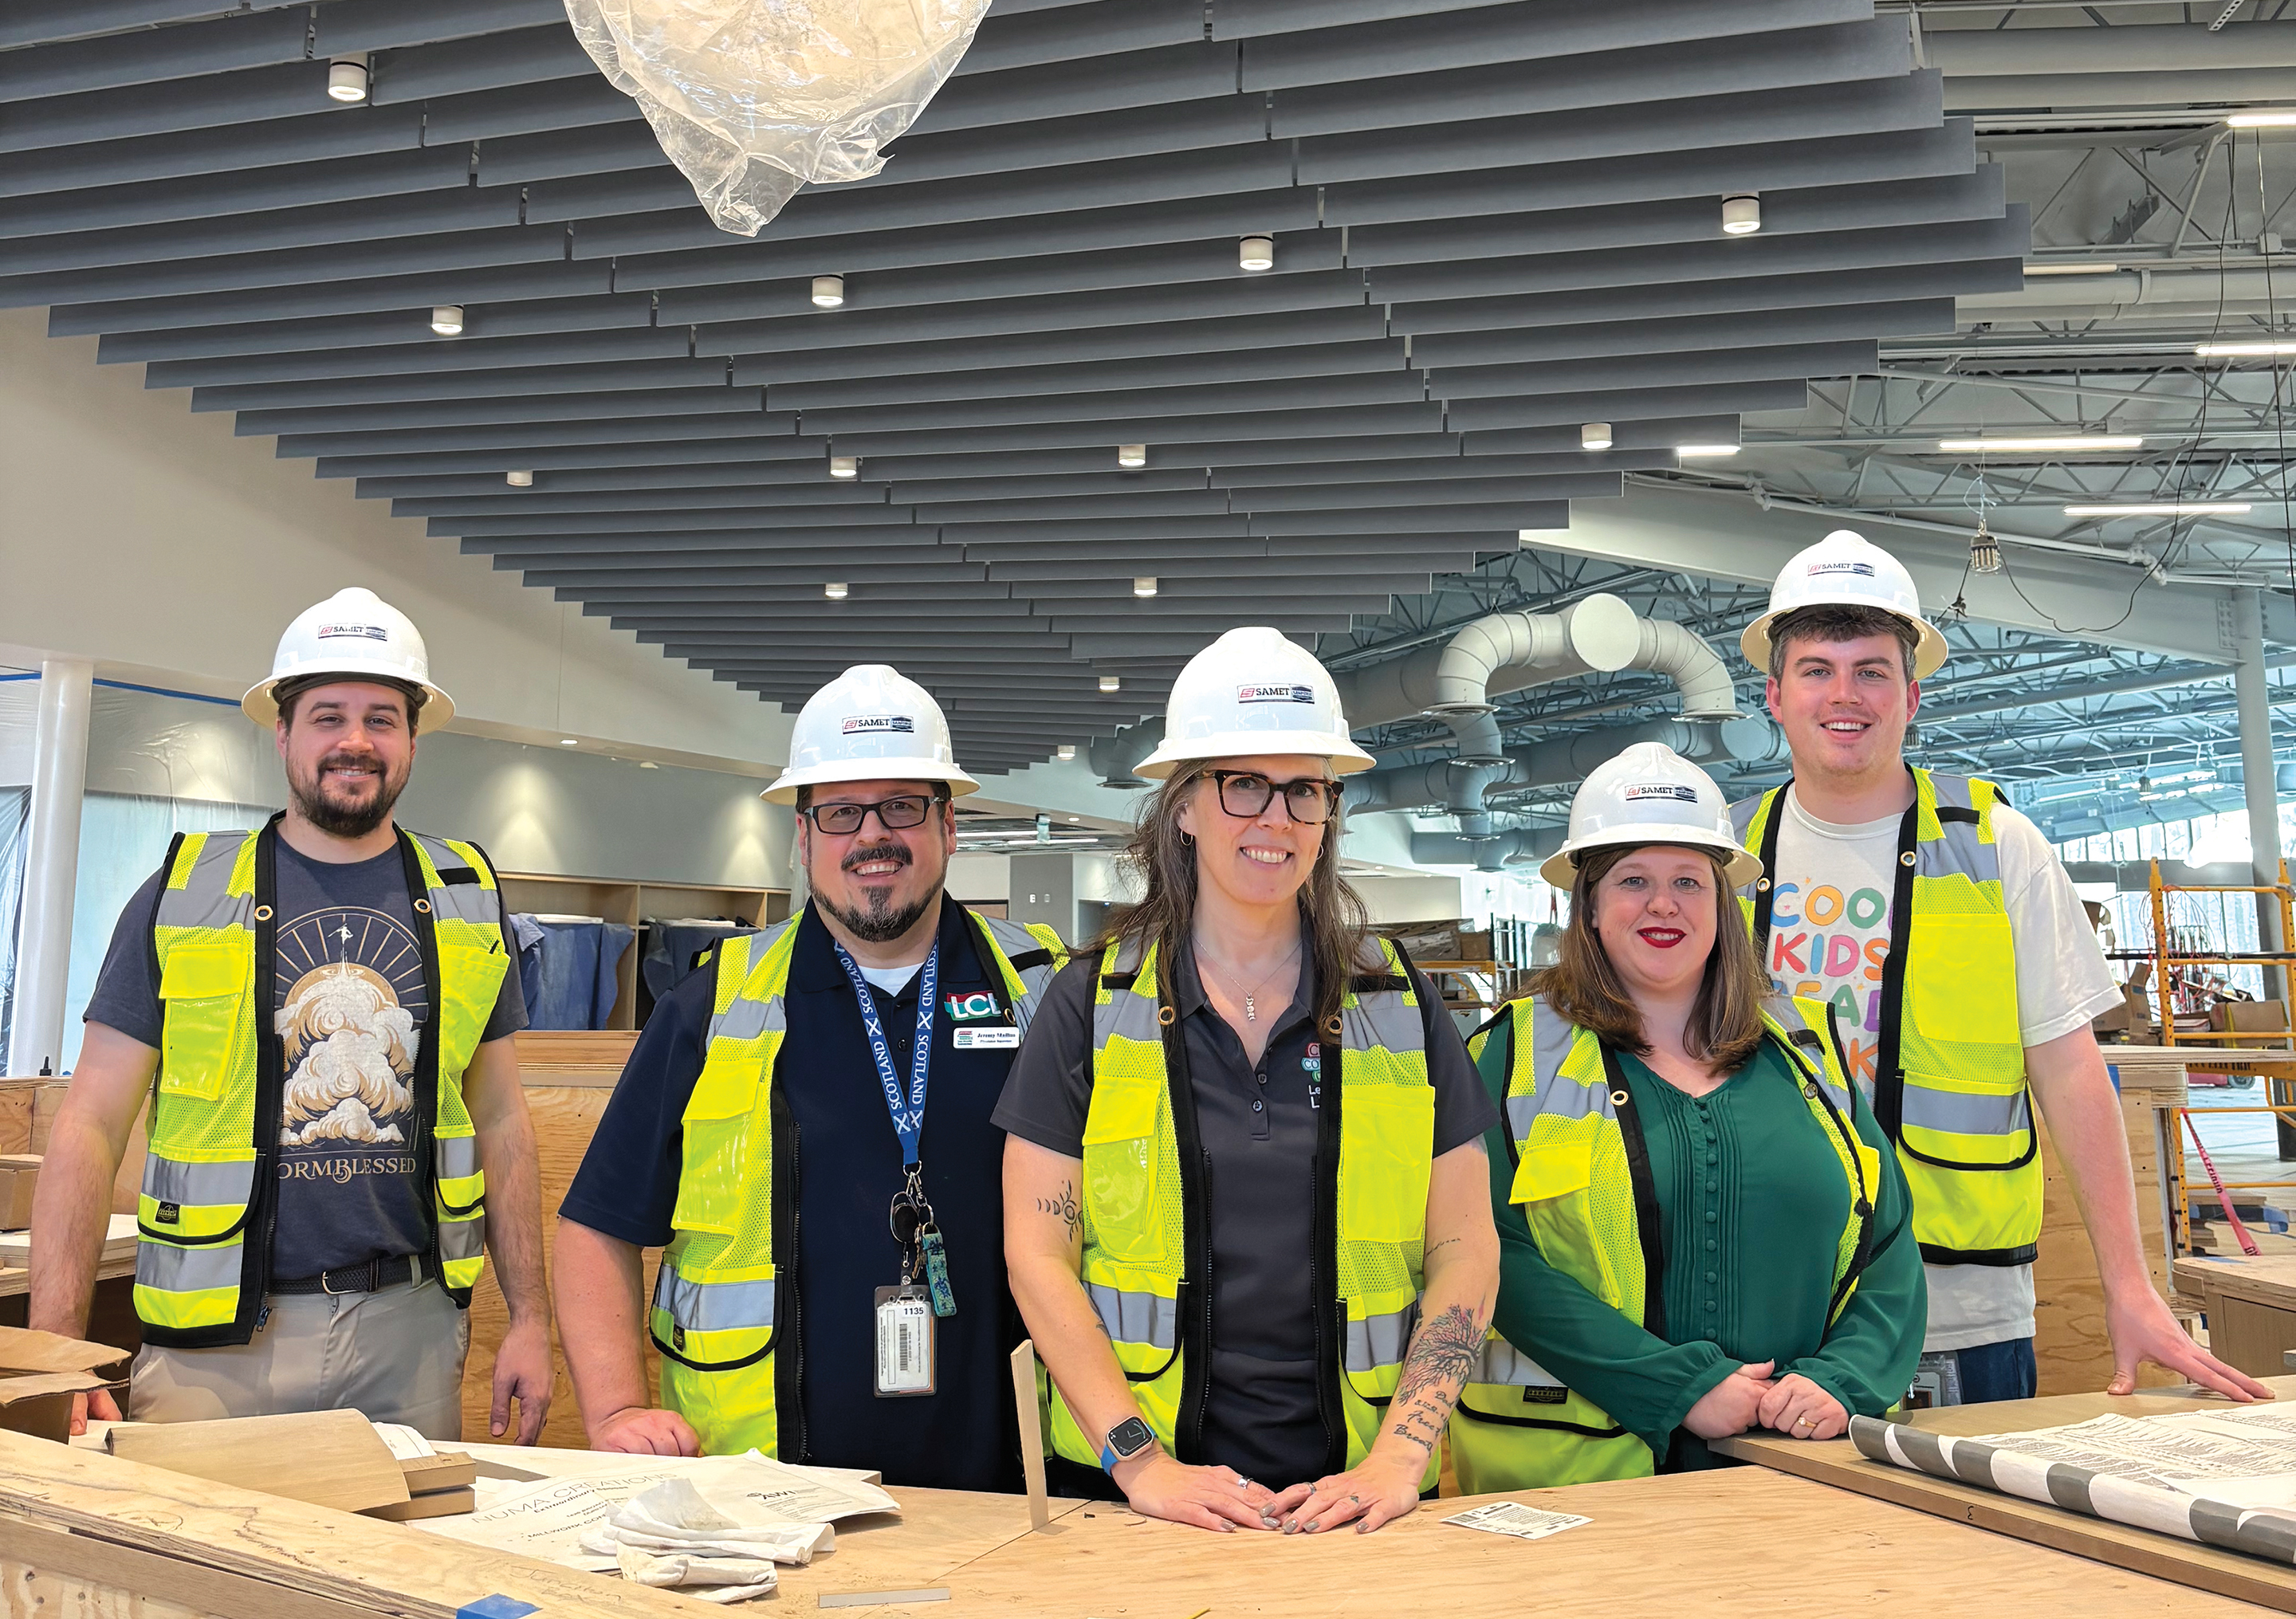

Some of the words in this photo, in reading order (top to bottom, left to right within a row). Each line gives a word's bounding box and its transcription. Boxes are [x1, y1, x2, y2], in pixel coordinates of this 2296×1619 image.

[1256, 687, 1290, 696] SAMET
[858, 718, 890, 727] SAMET
[1771, 882, 1893, 931] COO
[1772, 933, 1890, 981] KIDS
[839, 957, 874, 1014] SCOTLAND
[951, 992, 1001, 1019] LCL
[873, 1040, 902, 1111] SCOTLAND
[911, 1034, 929, 1105] SCOTLAND
[903, 1307, 925, 1315] 1135
[471, 1498, 552, 1524] NUMA
[552, 1472, 677, 1499] CREATIONS
[533, 1487, 596, 1515] Extraordinary
[527, 1523, 583, 1538] MILLWORK
